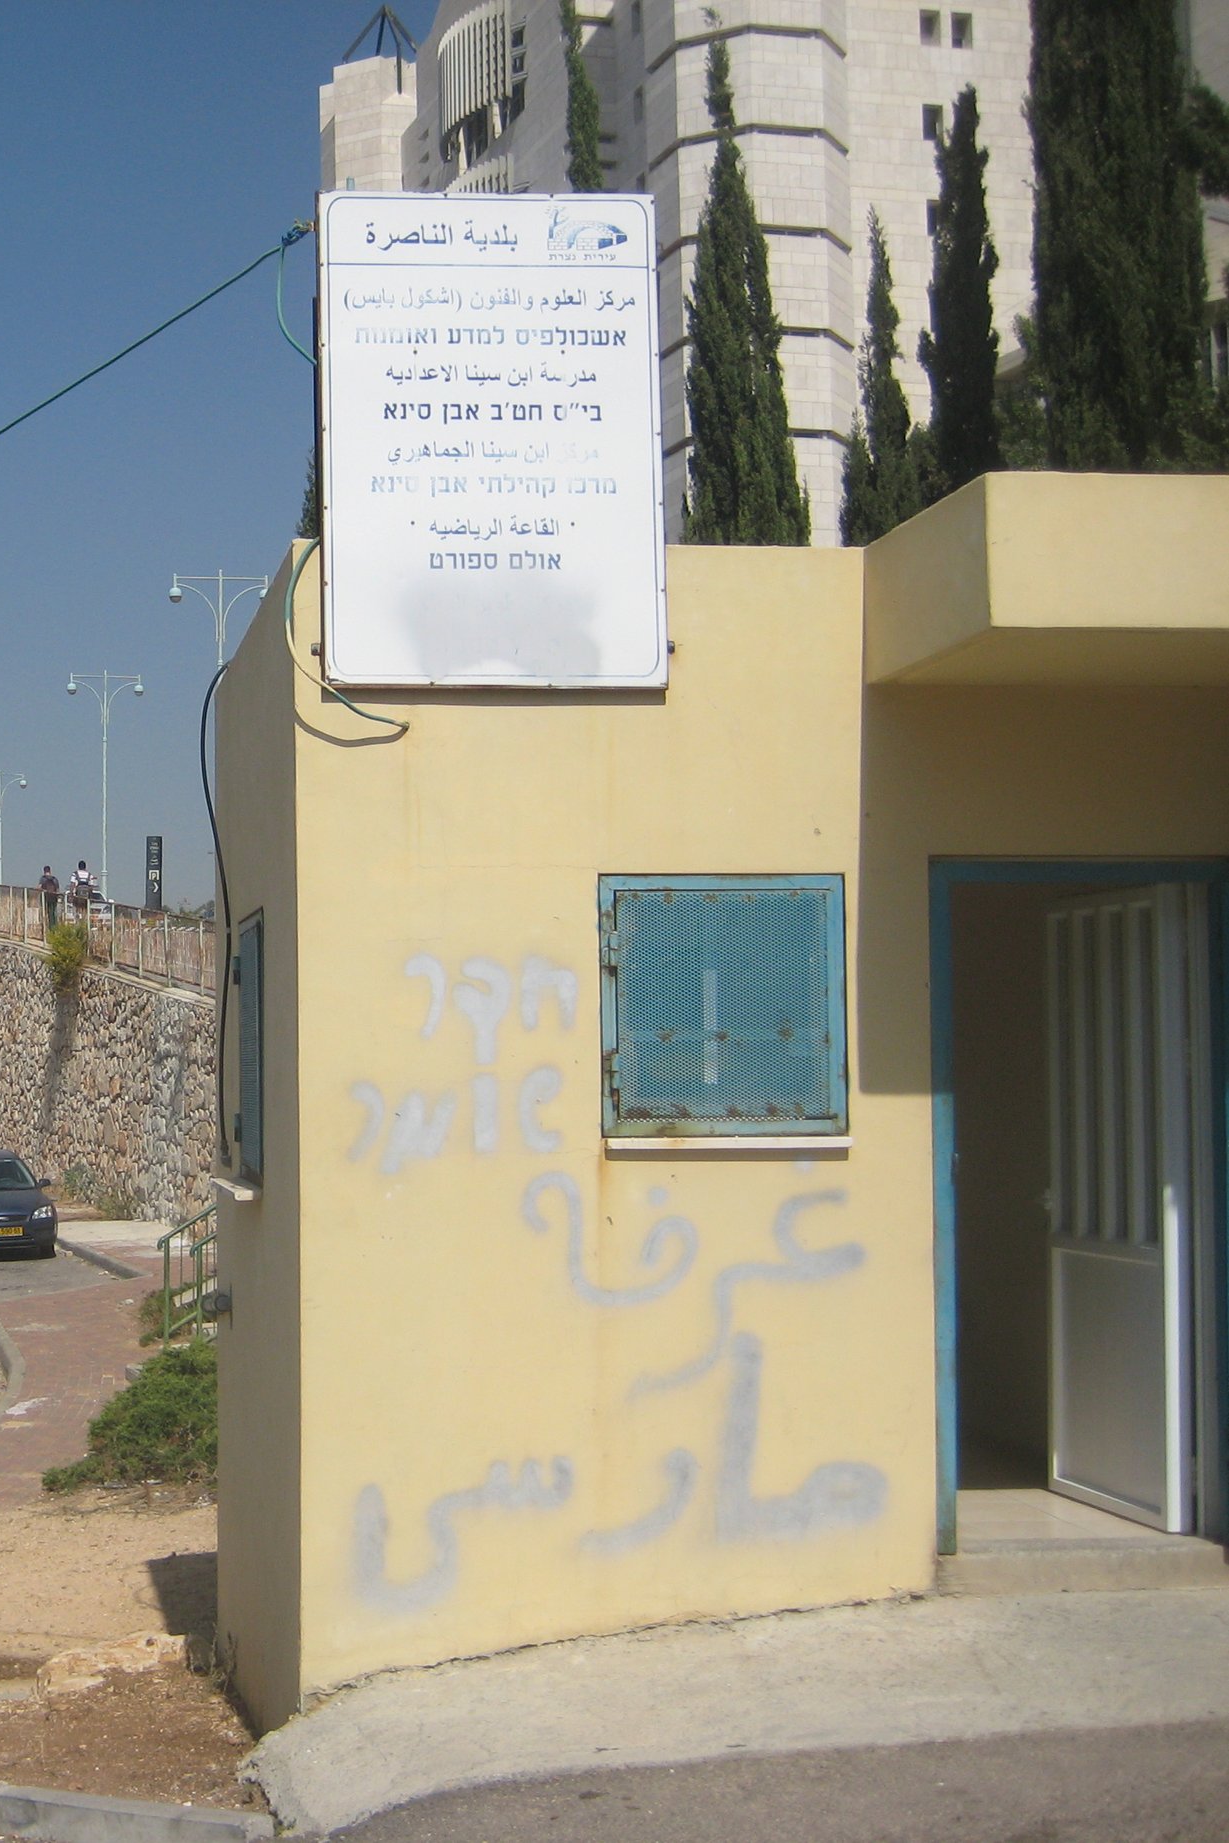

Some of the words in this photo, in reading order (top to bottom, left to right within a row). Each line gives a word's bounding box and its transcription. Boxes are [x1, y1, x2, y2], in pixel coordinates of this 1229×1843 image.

[366, 222, 453, 251] الناصرة
[463, 219, 518, 252] بلدية
[548, 253, 576, 262] נצרת
[540, 288, 586, 312] العلوم
[594, 290, 636, 312] مركز
[448, 326, 504, 345] למדע
[465, 364, 501, 387] سينا
[507, 366, 532, 387] ابن
[384, 402, 431, 420] סינא
[442, 403, 479, 425] אבן
[388, 440, 474, 466] الجماهيري
[482, 441, 517, 463] سينا
[524, 442, 549, 464] ابن
[430, 476, 467, 498] אבן
[478, 474, 555, 498] קהילתי
[510, 514, 559, 536] القاعة
[430, 552, 498, 570] ספורט
[509, 550, 561, 570] אולם
